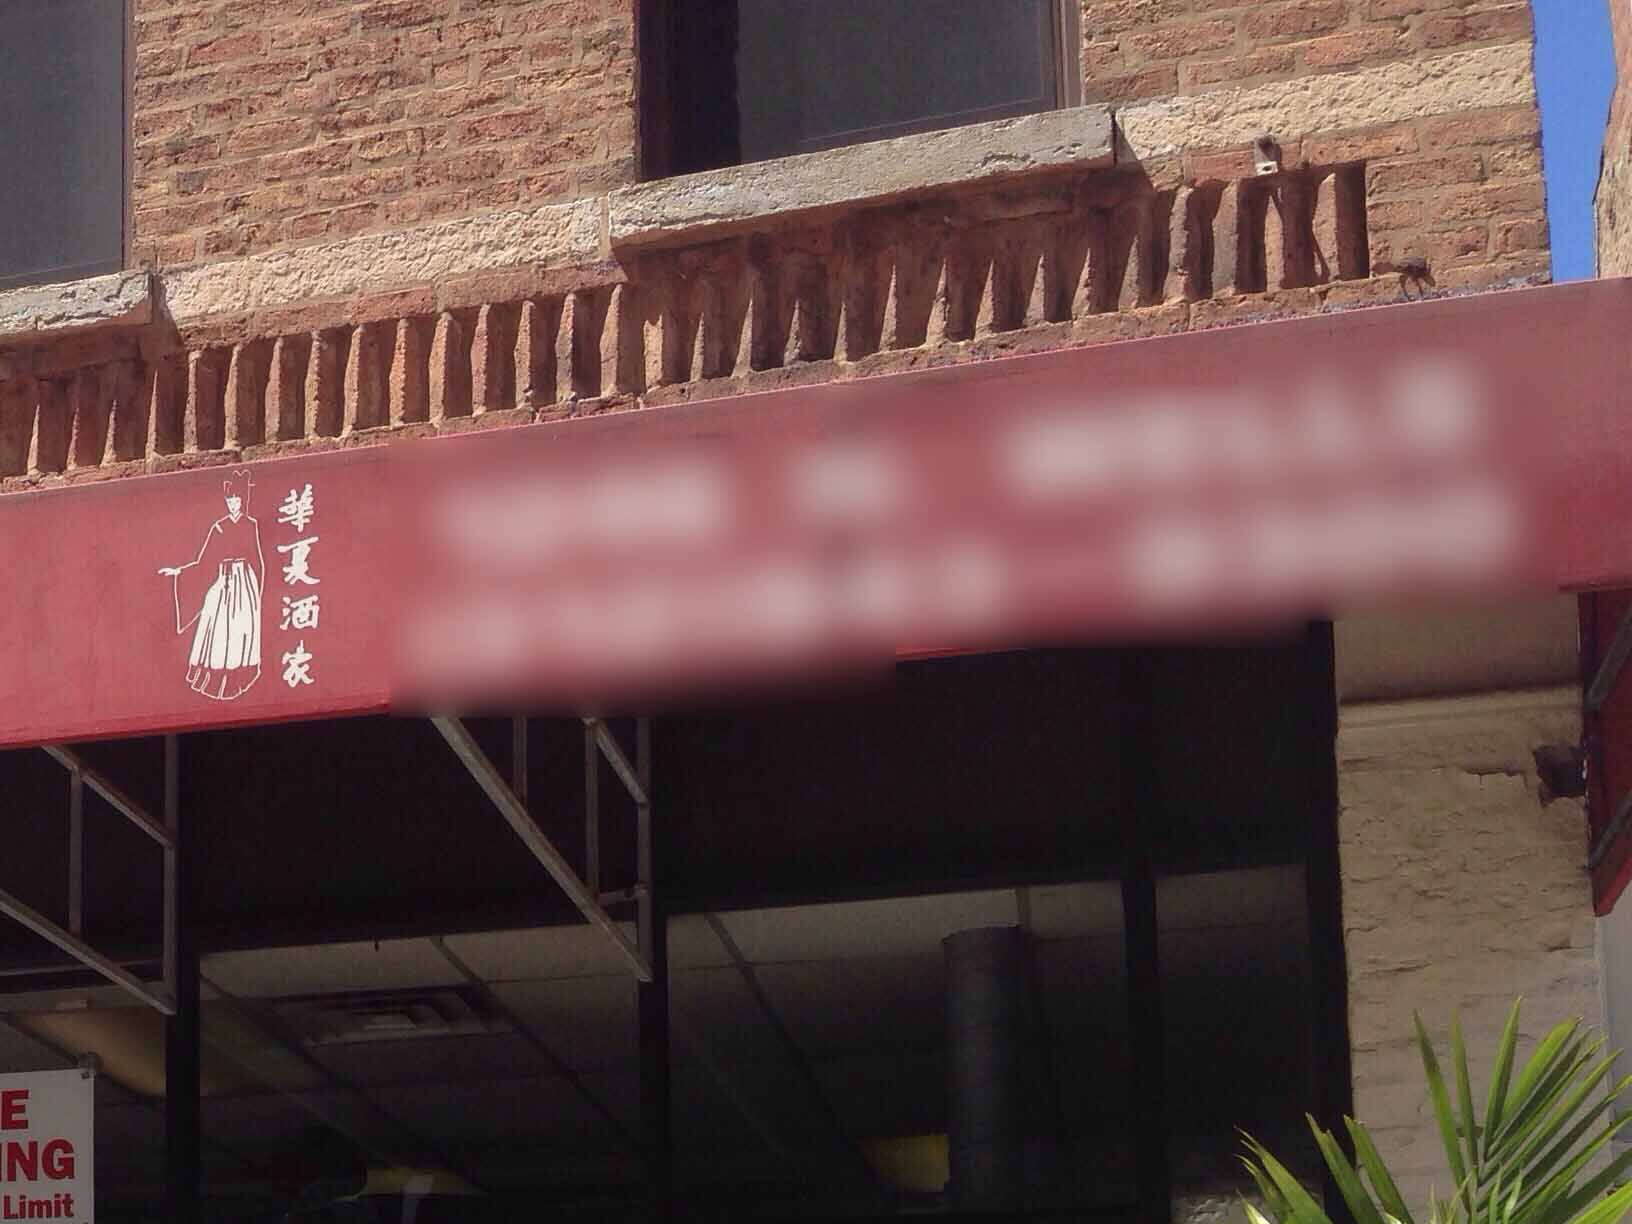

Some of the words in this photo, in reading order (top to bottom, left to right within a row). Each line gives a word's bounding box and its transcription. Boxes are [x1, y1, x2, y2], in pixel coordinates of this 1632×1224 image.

[277, 484, 321, 688] 華夏酒家
[3, 1194, 74, 1220] Limit
